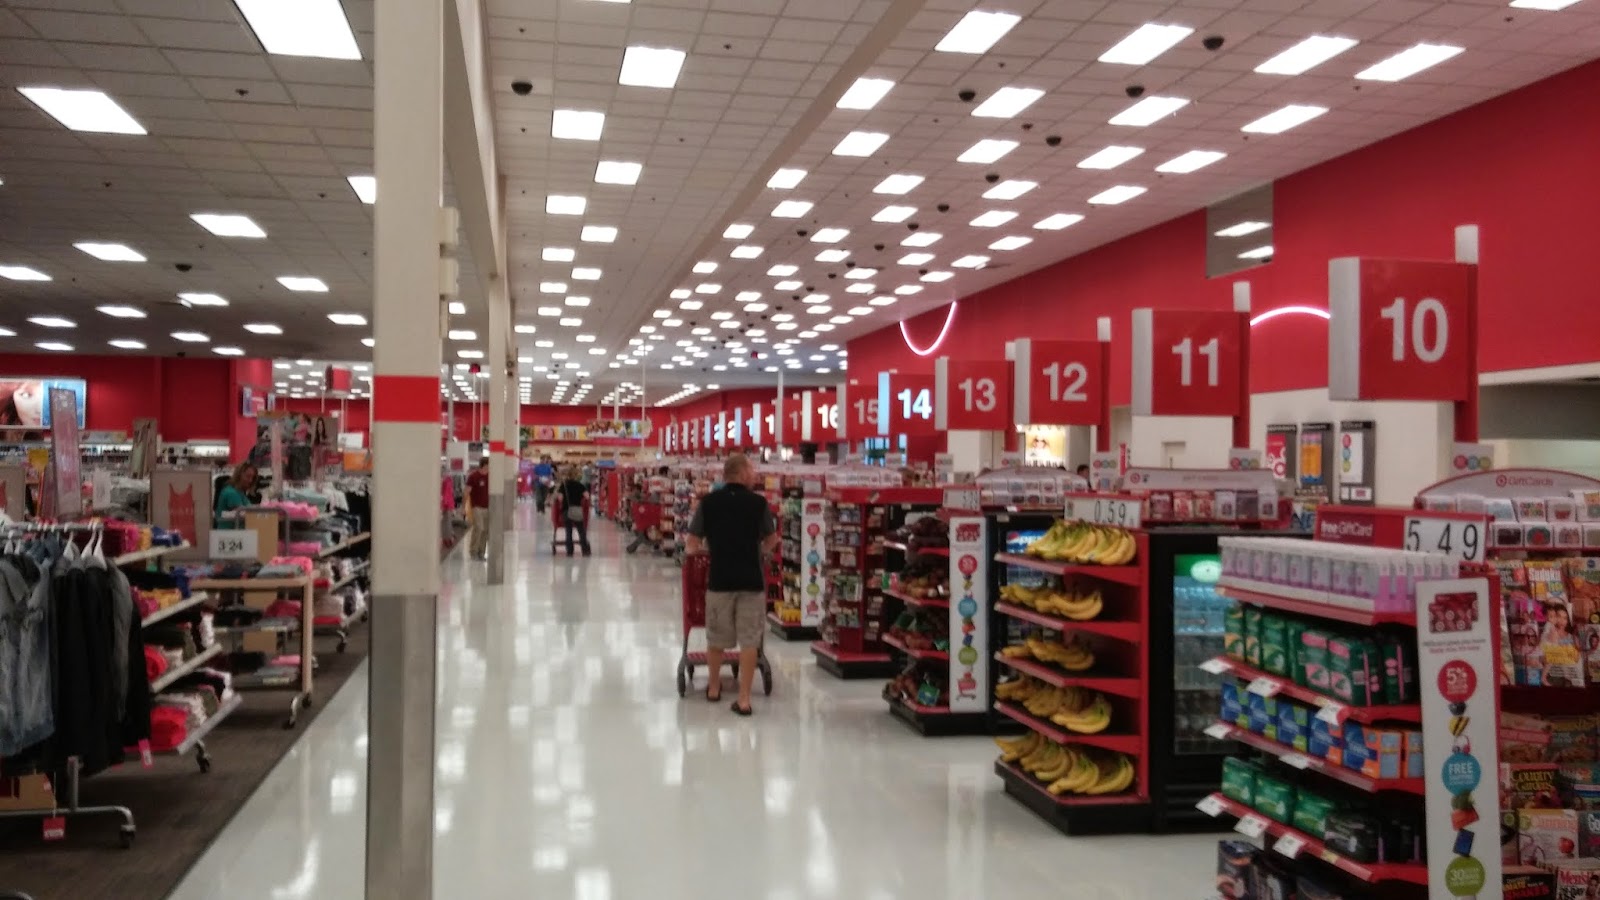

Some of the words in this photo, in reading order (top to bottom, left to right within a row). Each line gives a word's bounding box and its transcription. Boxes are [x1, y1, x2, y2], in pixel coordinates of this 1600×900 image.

[1380, 297, 1449, 363] 10
[1171, 337, 1219, 386] 11
[958, 378, 997, 412] 13
[1042, 362, 1088, 402] 12
[817, 403, 839, 430] 16
[853, 398, 879, 425] 15
[897, 388, 933, 420] 14
[1448, 761, 1474, 775] FREE
